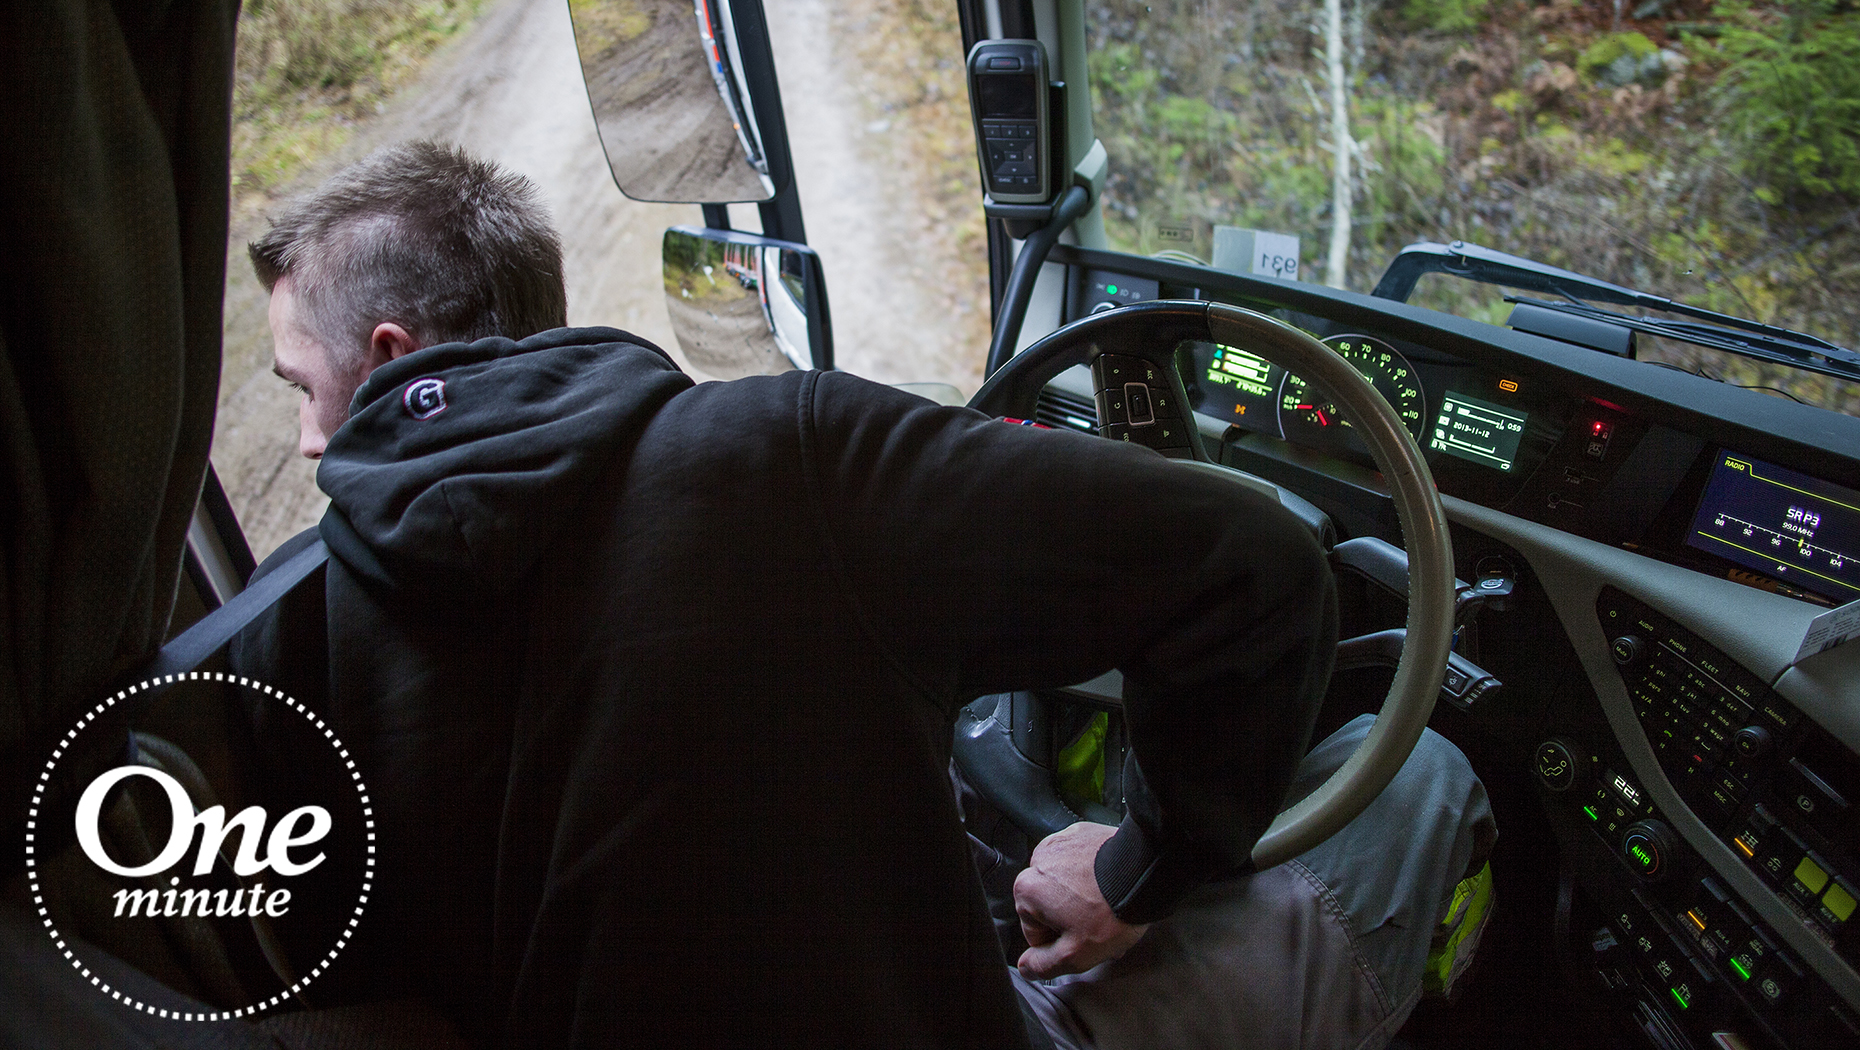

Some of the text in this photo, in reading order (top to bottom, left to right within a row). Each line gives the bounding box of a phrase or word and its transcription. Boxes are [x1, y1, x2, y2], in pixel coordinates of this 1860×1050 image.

[1340, 341, 1351, 351] 60
[1361, 343, 1372, 353] 70
[1380, 353, 1391, 363] 80
[1396, 367, 1407, 378] 90
[1289, 374, 1301, 385] 30
[1404, 387, 1417, 398] 100
[1283, 395, 1295, 404] 20
[1408, 410, 1419, 420] 110
[1453, 421, 1491, 439] 2013-11-12
[1724, 459, 1746, 472] RADIO
[1714, 518, 1725, 527] 88
[1786, 507, 1820, 528] SR P3
[1742, 527, 1753, 537] 92
[1782, 521, 1815, 539] 99.0 MHz
[1770, 537, 1781, 547] 96
[1799, 547, 1812, 557] 100
[1776, 564, 1787, 573] AF
[1829, 558, 1843, 569] 104
[1638, 620, 1654, 632] AUDIO
[1668, 638, 1687, 653] PHONE
[1701, 660, 1719, 675] FLEET
[1735, 685, 1751, 698] NAVI
[1764, 706, 1787, 727] CAMERA
[1722, 778, 1735, 791] ESC
[1713, 790, 1727, 804] MISC
[1631, 844, 1651, 867] AUTO
